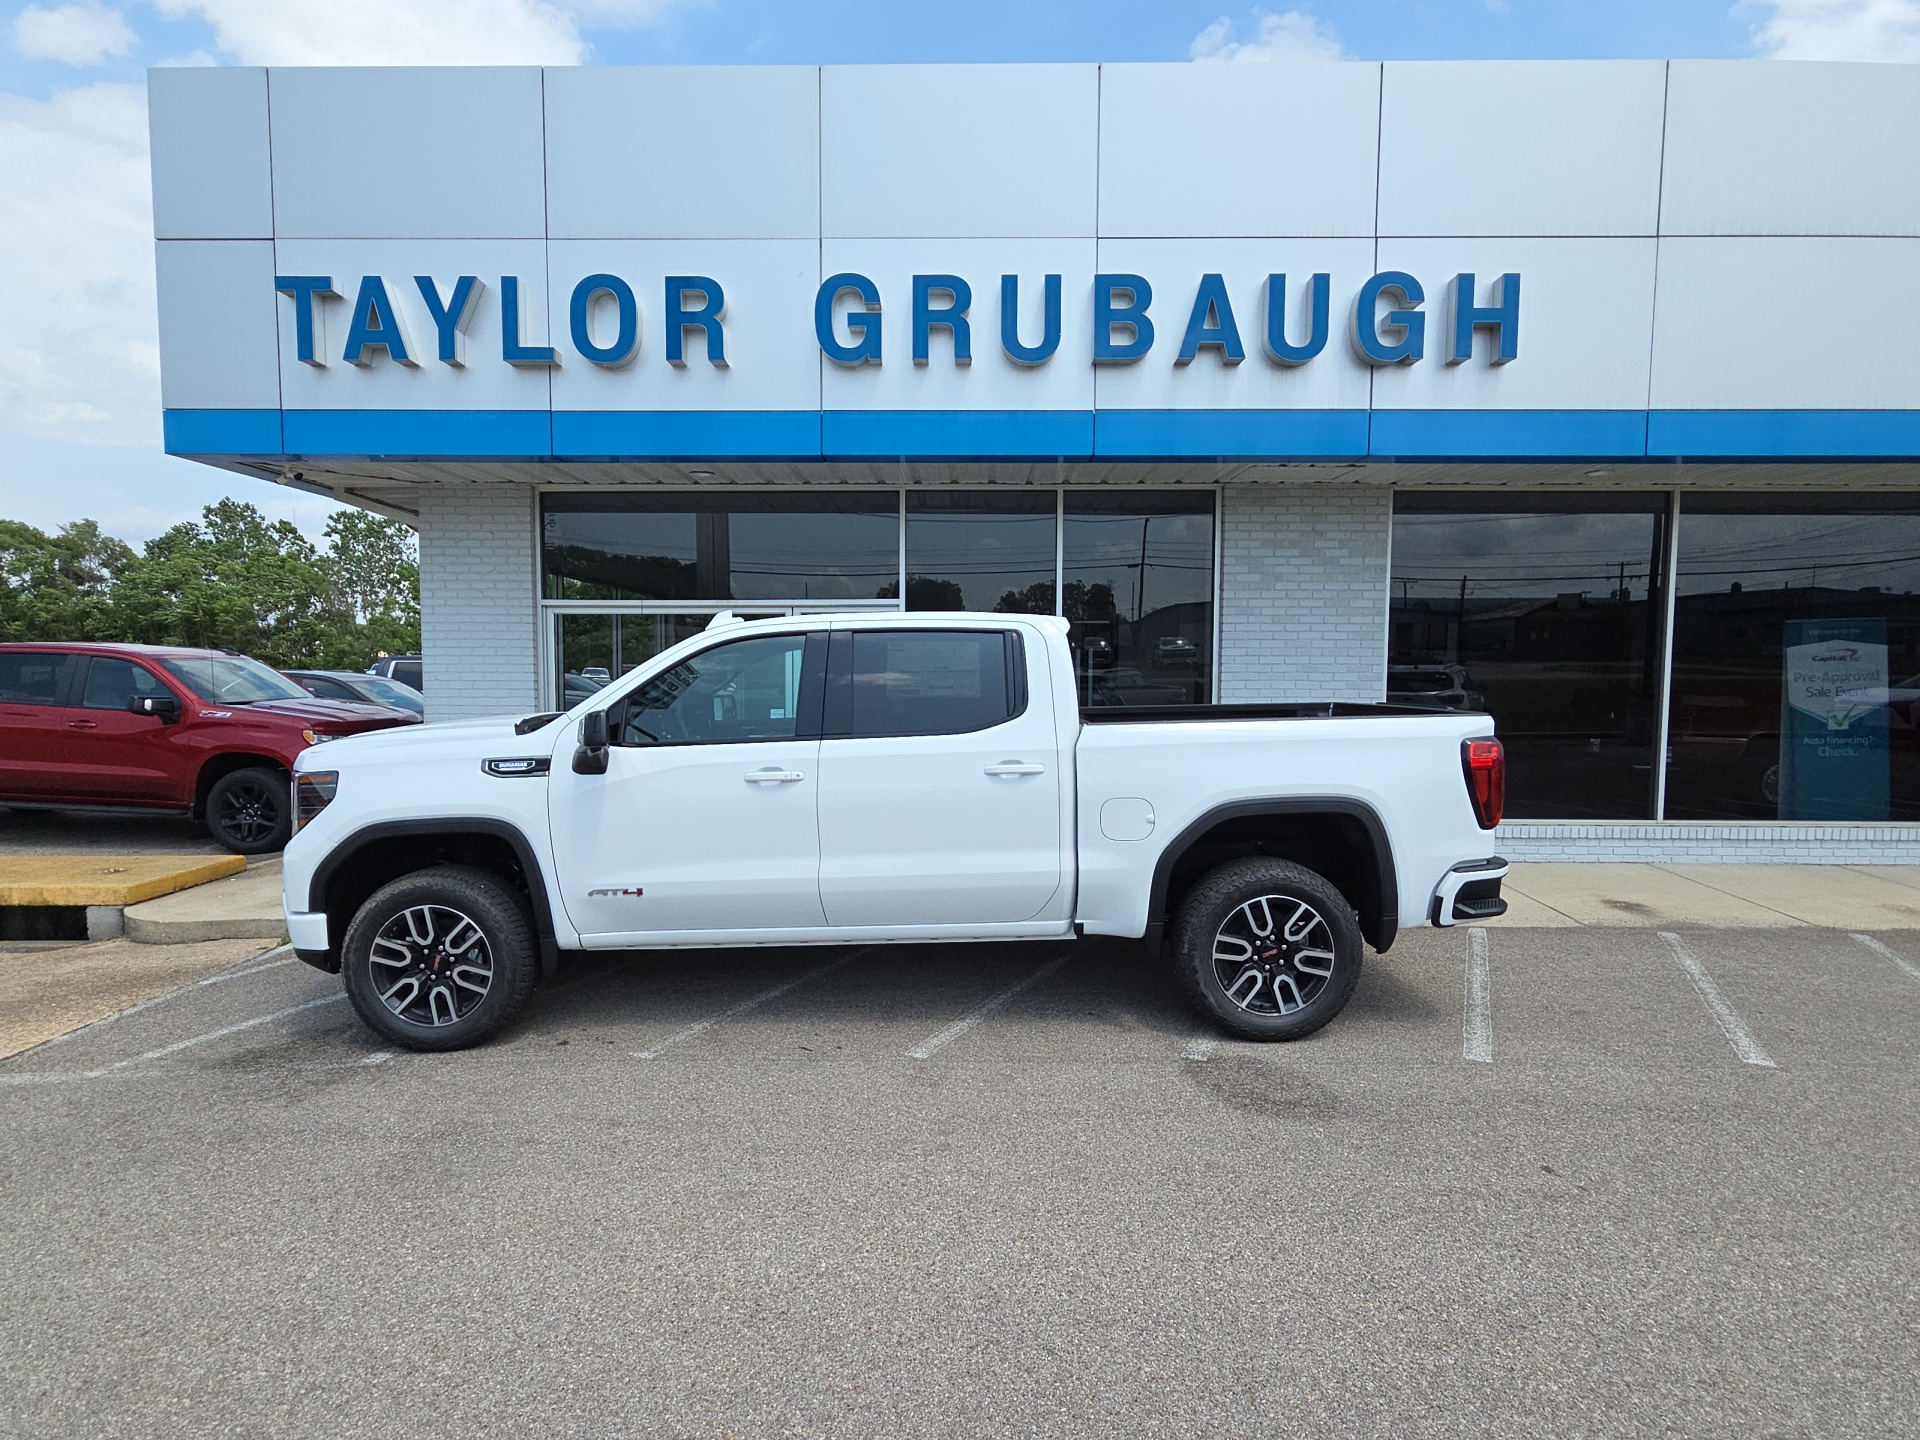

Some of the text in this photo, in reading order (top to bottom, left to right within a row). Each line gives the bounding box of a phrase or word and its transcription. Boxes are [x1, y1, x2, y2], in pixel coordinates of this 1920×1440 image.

[274, 271, 1521, 368] TAYLOR GRUBAUGH
[1793, 669, 1880, 684] Pre-Approval
[1806, 685, 1868, 697] Sale Event
[1802, 735, 1873, 746] Auto financing?
[1817, 746, 1860, 757] Check.
